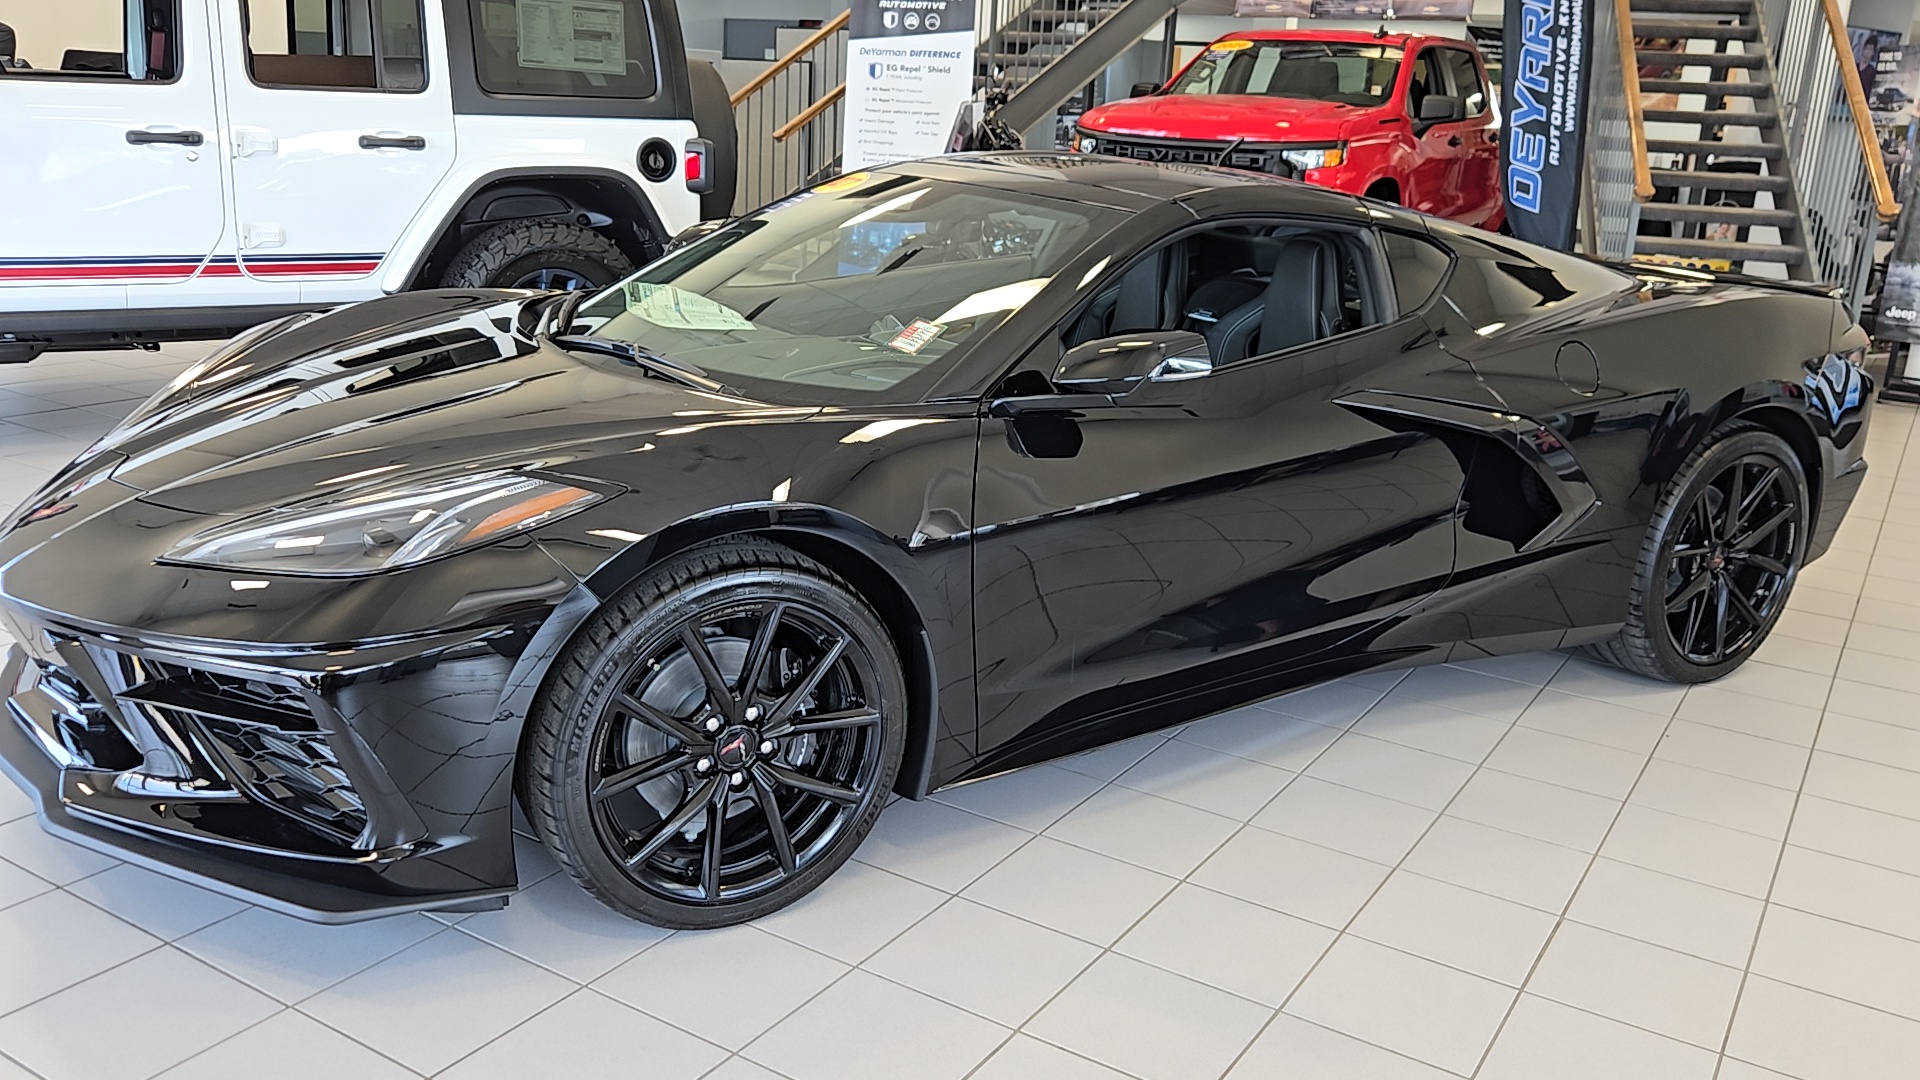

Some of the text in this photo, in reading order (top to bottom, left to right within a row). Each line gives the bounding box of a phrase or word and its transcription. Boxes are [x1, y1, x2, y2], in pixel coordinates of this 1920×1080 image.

[879, 0, 947, 10] AUTOMOTIVE
[859, 47, 962, 59] DeYarman DIFFERENCE
[886, 64, 951, 74] EG Repel Shield
[1100, 144, 1270, 167] CHEVROLET
[1885, 305, 1917, 322] Jeep
[570, 661, 616, 753] MICHELIN
